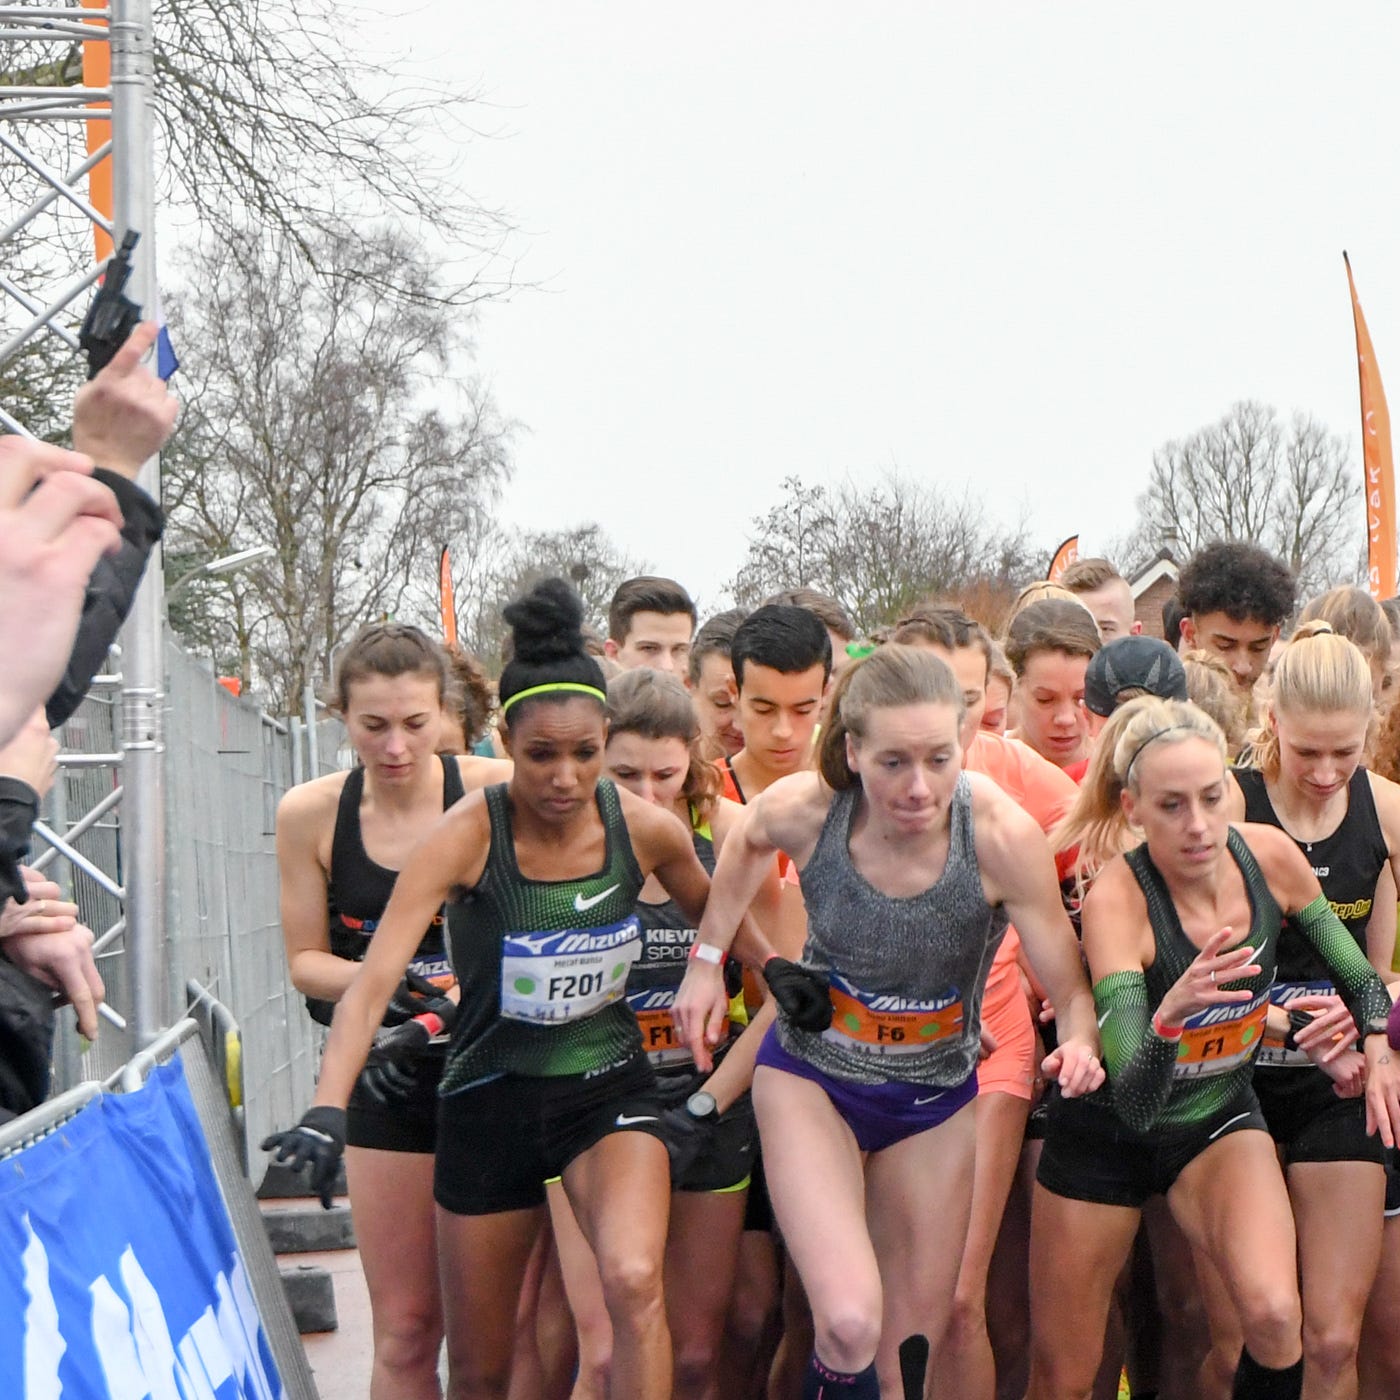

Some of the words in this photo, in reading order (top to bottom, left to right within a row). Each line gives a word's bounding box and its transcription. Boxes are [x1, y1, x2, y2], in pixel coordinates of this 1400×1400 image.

[646, 928, 698, 943] KIEVI
[647, 945, 691, 960] SPO
[548, 971, 603, 1000] F201
[877, 1023, 906, 1042] F6
[1201, 1036, 1225, 1058] F1
